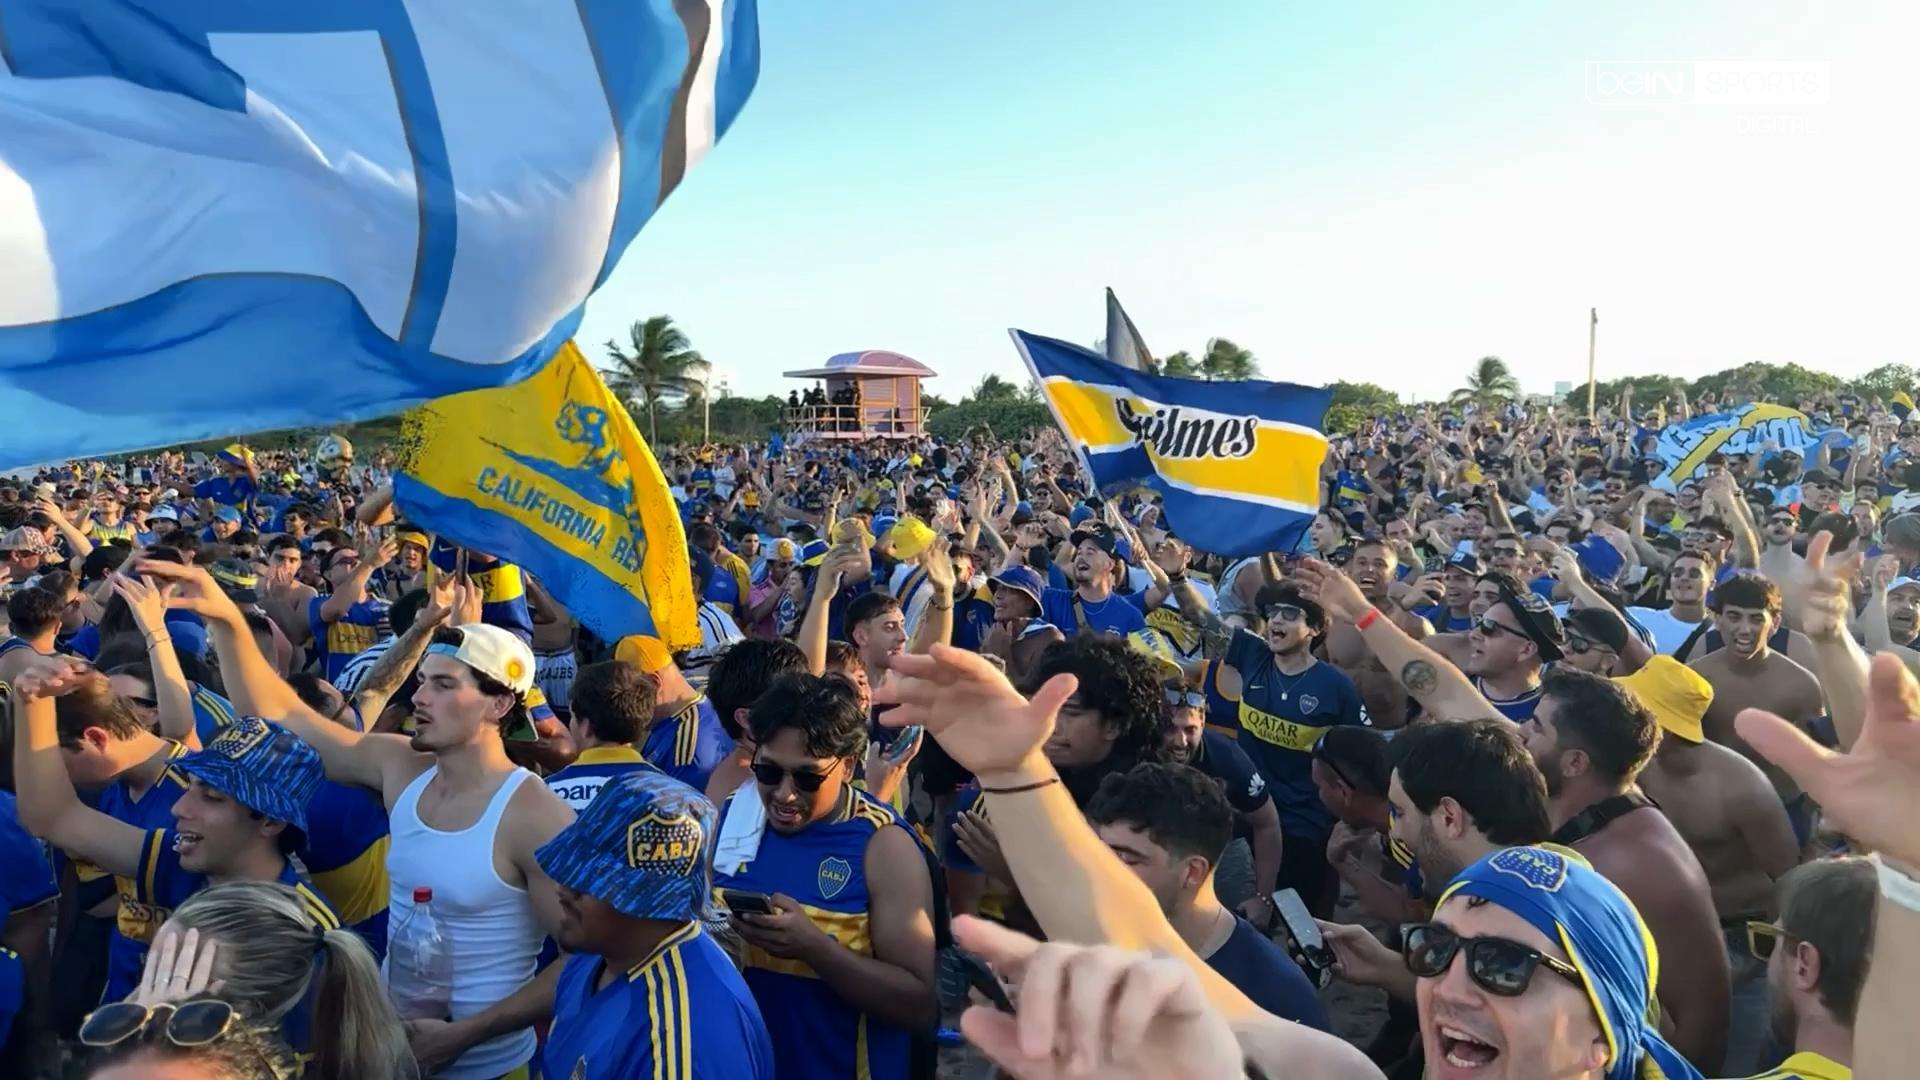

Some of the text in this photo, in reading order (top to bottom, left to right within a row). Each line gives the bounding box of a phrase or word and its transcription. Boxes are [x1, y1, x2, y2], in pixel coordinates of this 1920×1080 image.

[476, 466, 607, 551] CALIFORNIA
[1247, 710, 1299, 739] QATAR
[636, 840, 696, 862] CABJ
